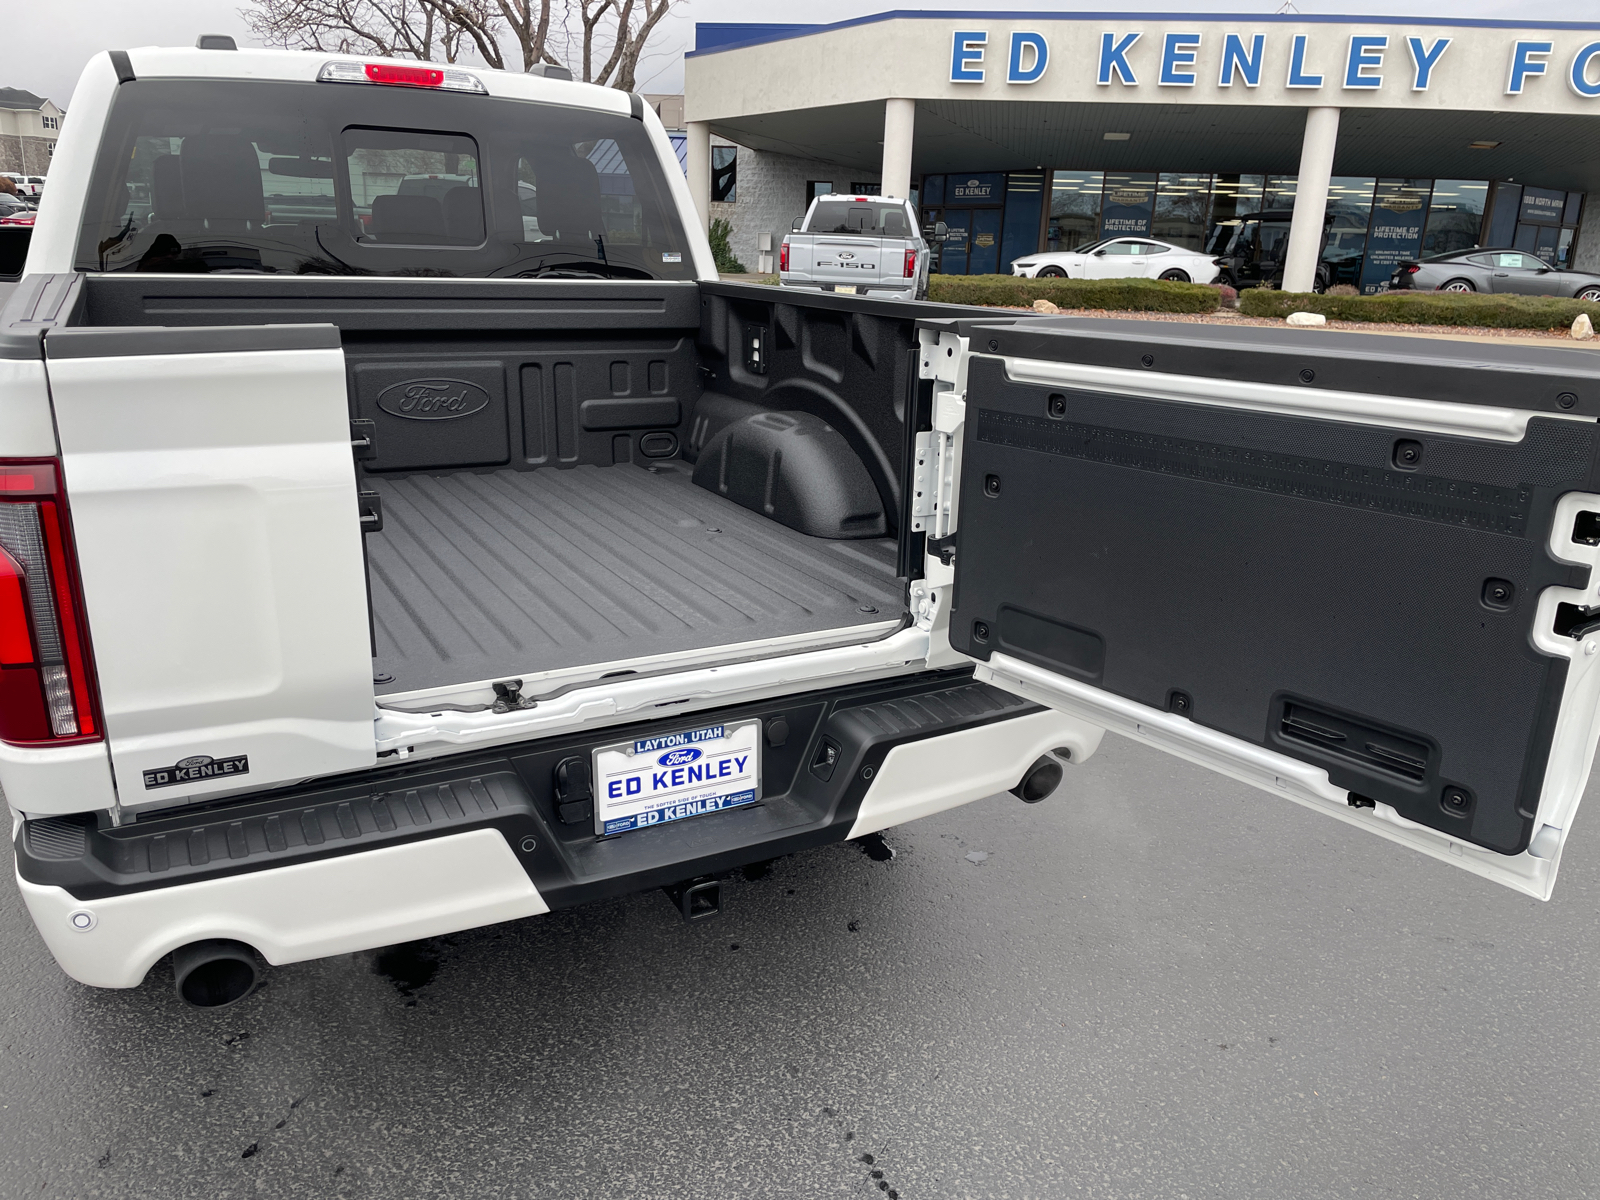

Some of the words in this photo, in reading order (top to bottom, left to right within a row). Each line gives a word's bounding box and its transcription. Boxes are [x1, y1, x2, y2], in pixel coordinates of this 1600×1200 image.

[950, 30, 1050, 84] ED
[1096, 31, 1453, 92] KENLEY
[955, 188, 964, 196] ED
[965, 187, 991, 195] KENLEY
[817, 261, 876, 270] F-150
[399, 384, 468, 412] Ford
[637, 734, 688, 752] LAYTON,
[691, 727, 722, 742] UTAH
[185, 758, 205, 767] Ford
[666, 750, 694, 765] Ford
[145, 772, 169, 785] ED
[175, 759, 246, 780] KENLEY
[608, 776, 642, 799] ED
[653, 755, 749, 790] KENLEY
[699, 791, 717, 799] TOUGH
[637, 811, 659, 827] ED
[664, 796, 727, 820] KENLEY
